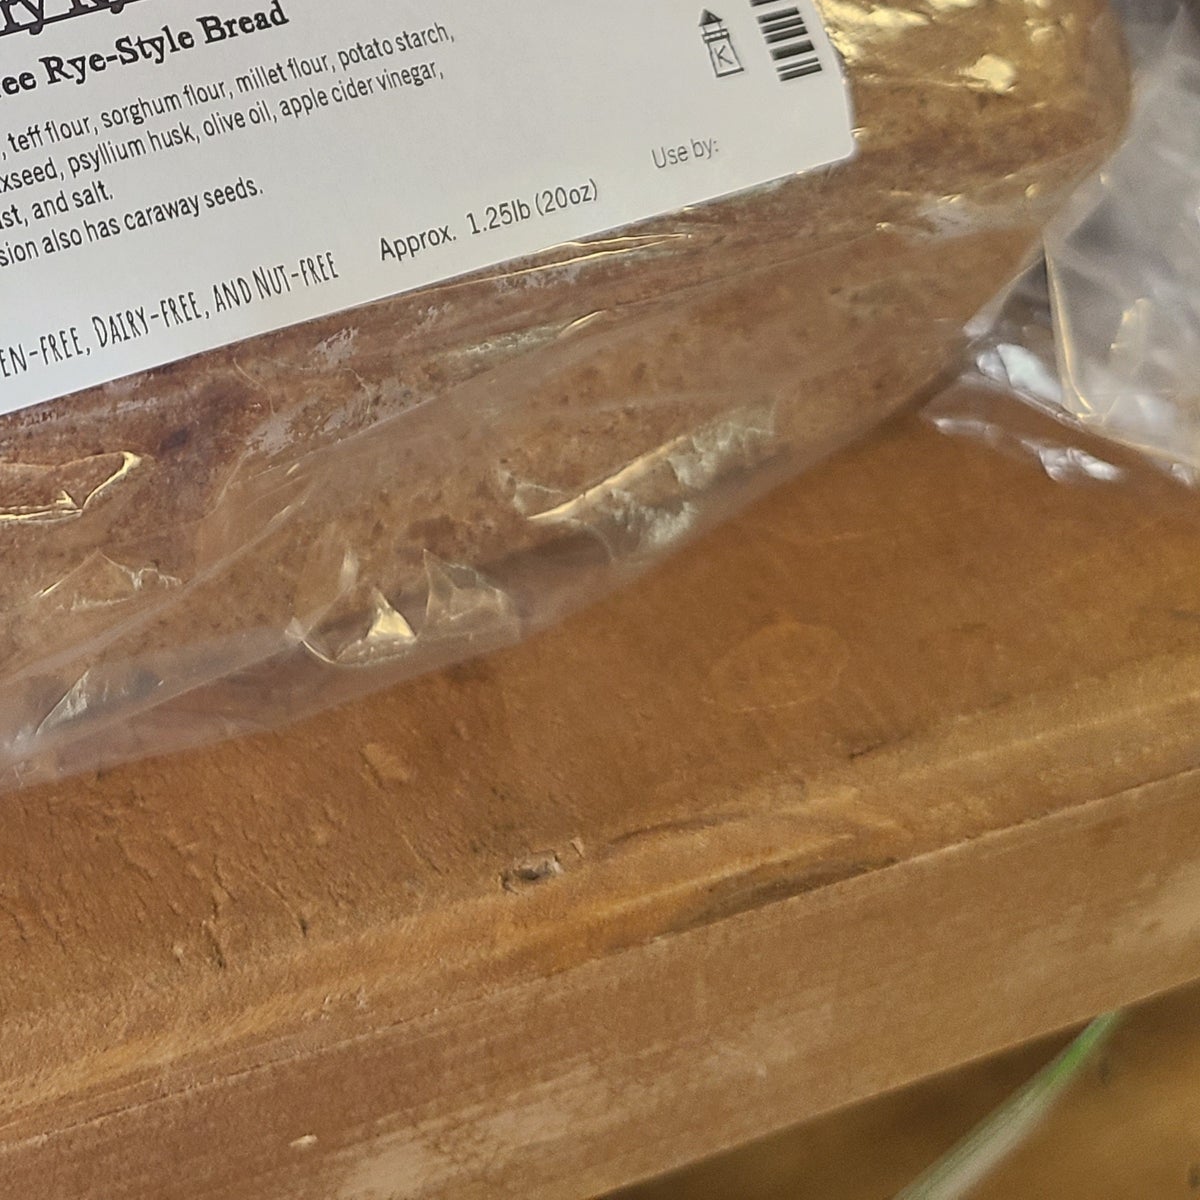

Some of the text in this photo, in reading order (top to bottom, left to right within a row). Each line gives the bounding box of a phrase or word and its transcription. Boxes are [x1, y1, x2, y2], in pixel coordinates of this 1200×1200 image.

[7, 124, 44, 153] teff
[44, 116, 99, 144] flour,
[100, 93, 183, 129] sorghum
[182, 81, 234, 106] flour,
[235, 62, 288, 93] millet
[286, 54, 336, 80] flour,
[337, 38, 394, 71] potato
[395, 22, 455, 52] starch,
[38, 25, 195, 85] Rye-Style
[67, 138, 147, 179] psyllium
[146, 121, 200, 152] husk,
[203, 111, 246, 137] olive
[248, 100, 278, 125] oil,
[278, 87, 329, 119] apple
[331, 77, 374, 103] cider
[375, 61, 444, 91] vinegar,
[651, 138, 719, 169] Use by:
[31, 190, 70, 220] and
[71, 180, 114, 209] salt.
[41, 228, 83, 254] also
[83, 217, 121, 242] has
[123, 194, 200, 231] caraway
[203, 176, 264, 209] seeds.
[380, 178, 598, 262] Approx. 1.25lb (20oz)
[213, 277, 252, 313] AND
